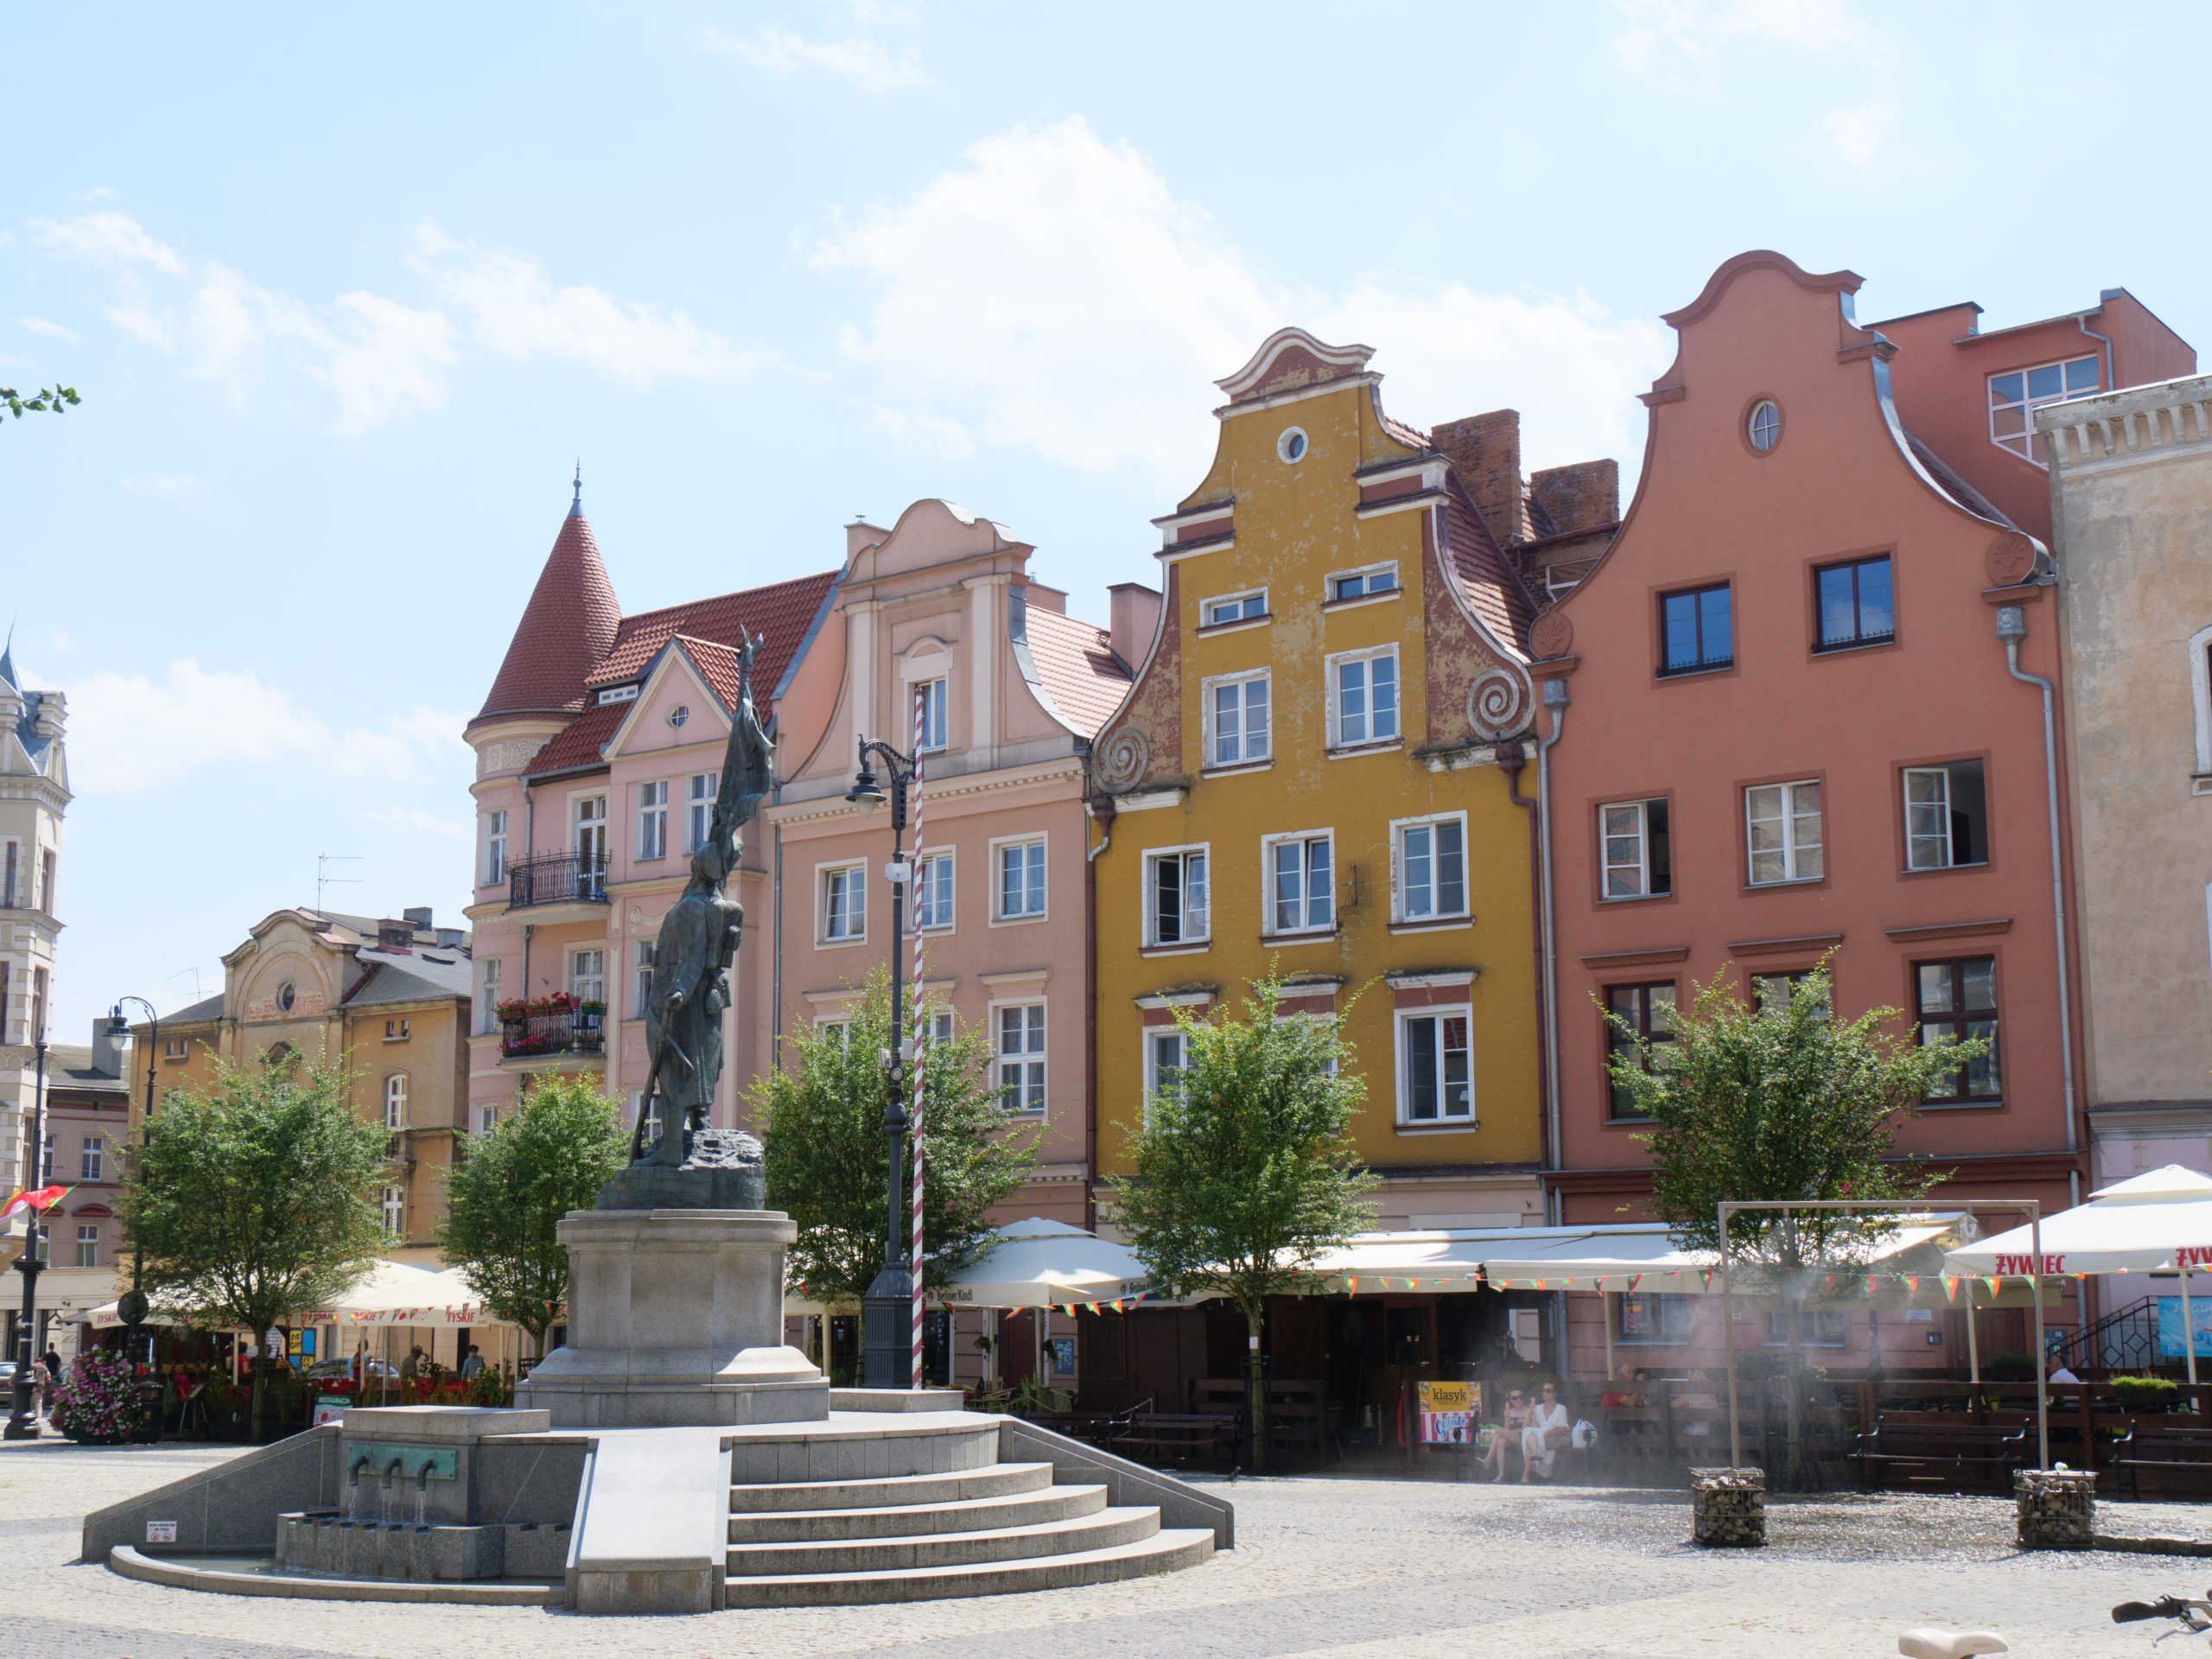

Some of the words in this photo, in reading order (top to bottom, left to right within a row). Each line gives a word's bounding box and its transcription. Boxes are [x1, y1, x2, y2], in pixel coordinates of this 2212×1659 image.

[1995, 1253, 2066, 1275] ŻYWIEC
[937, 1289, 957, 1301] Berliner
[957, 1288, 973, 1301] Kindl
[97, 1313, 118, 1325] TYSKIE
[447, 1312, 476, 1323] TYSKIE
[1433, 1388, 1467, 1402] klasyk
